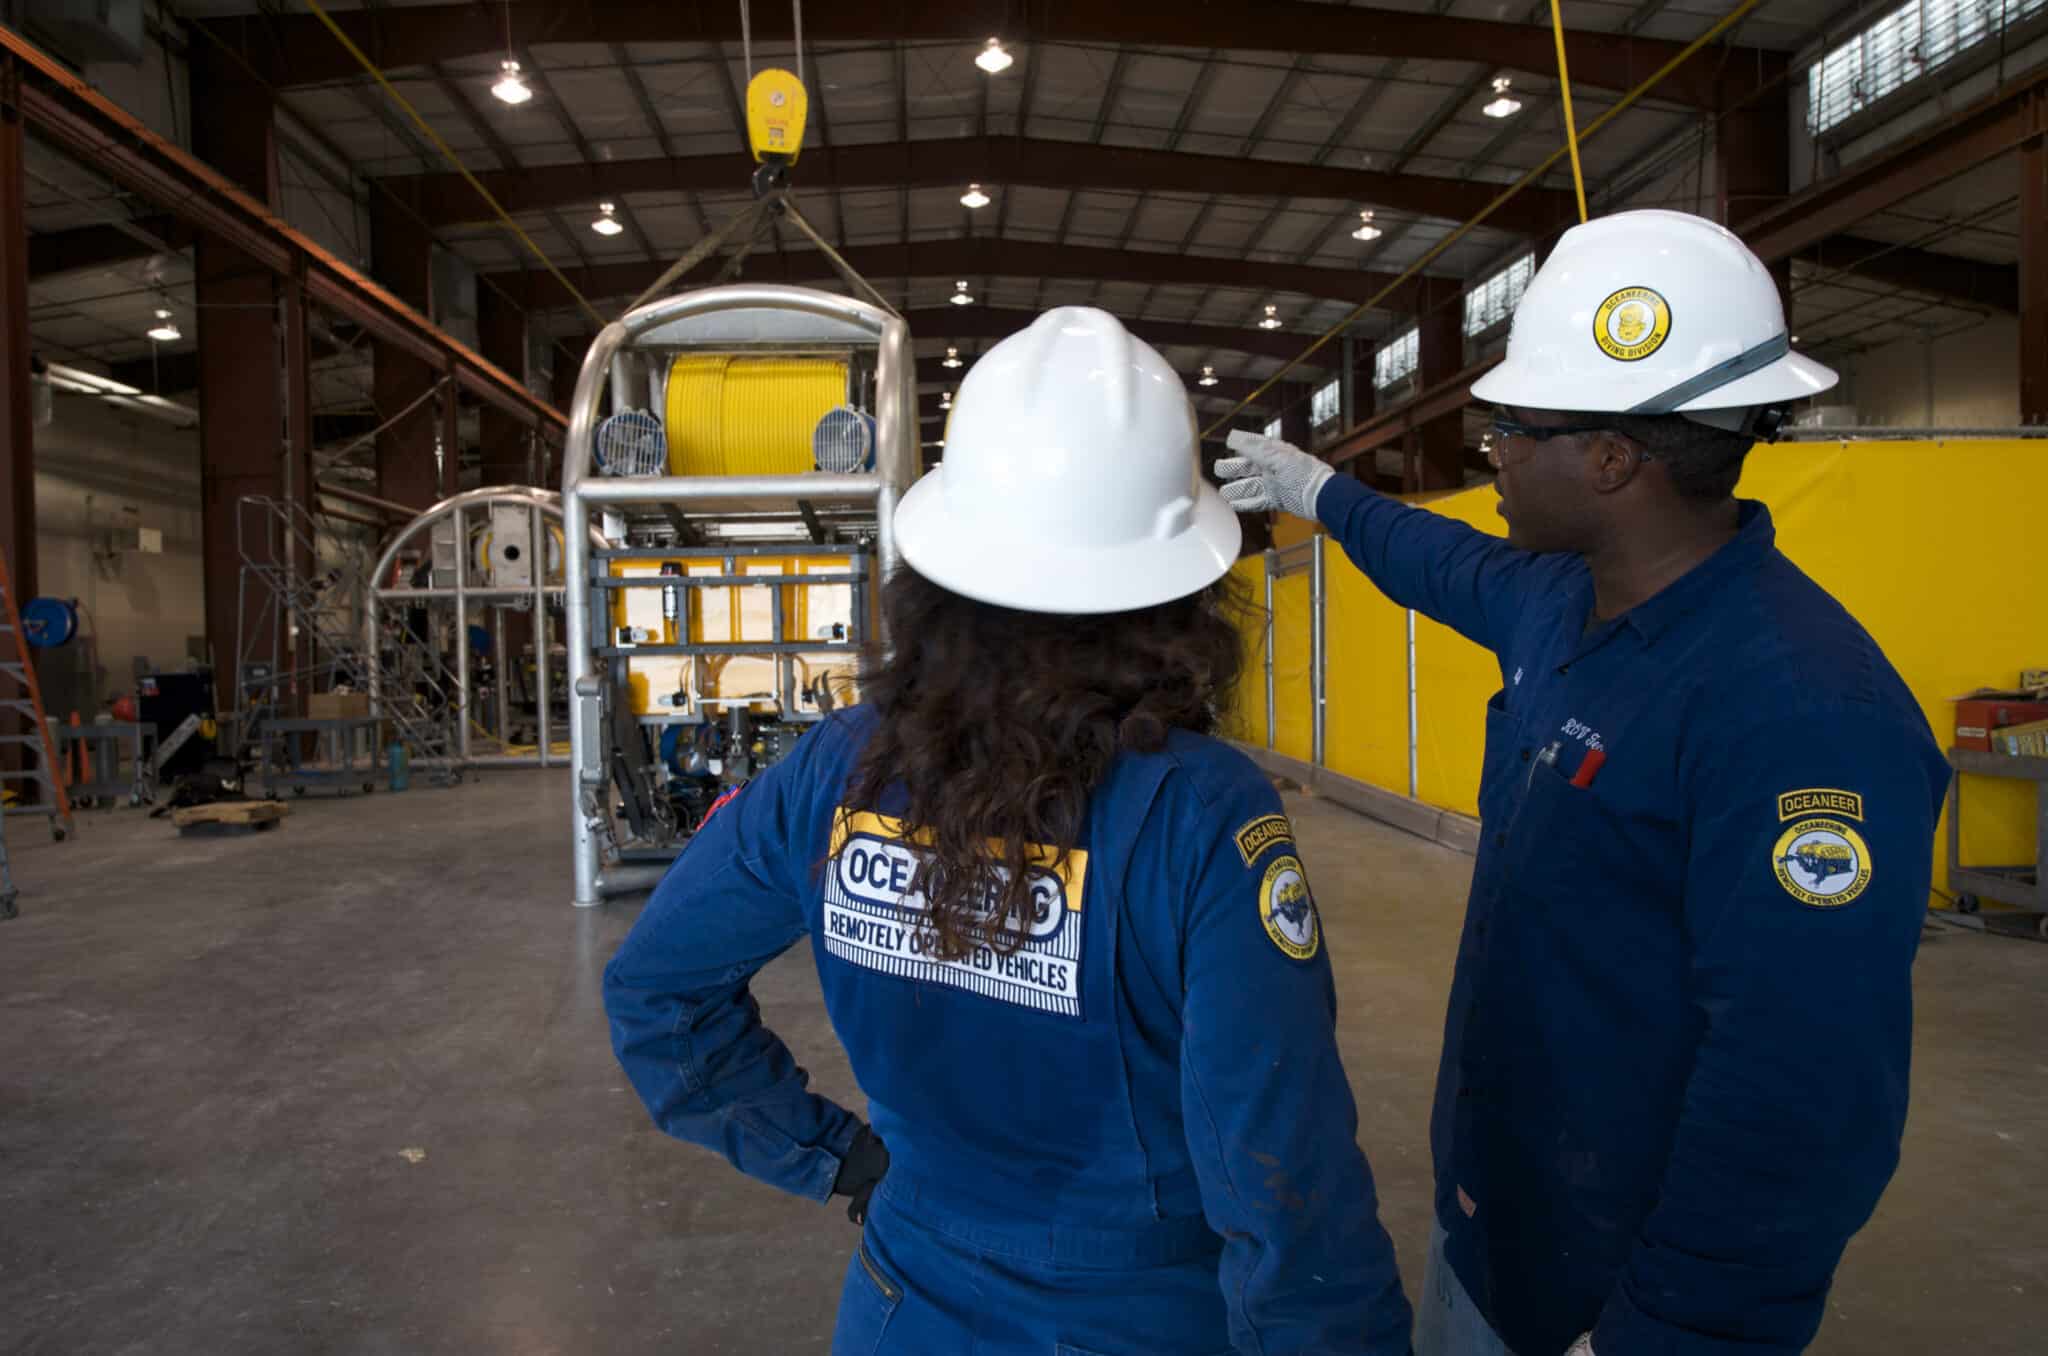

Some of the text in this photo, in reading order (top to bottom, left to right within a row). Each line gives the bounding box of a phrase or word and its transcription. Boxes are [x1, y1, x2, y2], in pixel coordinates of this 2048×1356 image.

[1627, 332, 1662, 357] DIVISION
[1784, 794, 1857, 812] OCEANEER
[829, 911, 907, 950] REMOTELY
[996, 952, 1068, 992] VEHICLES
